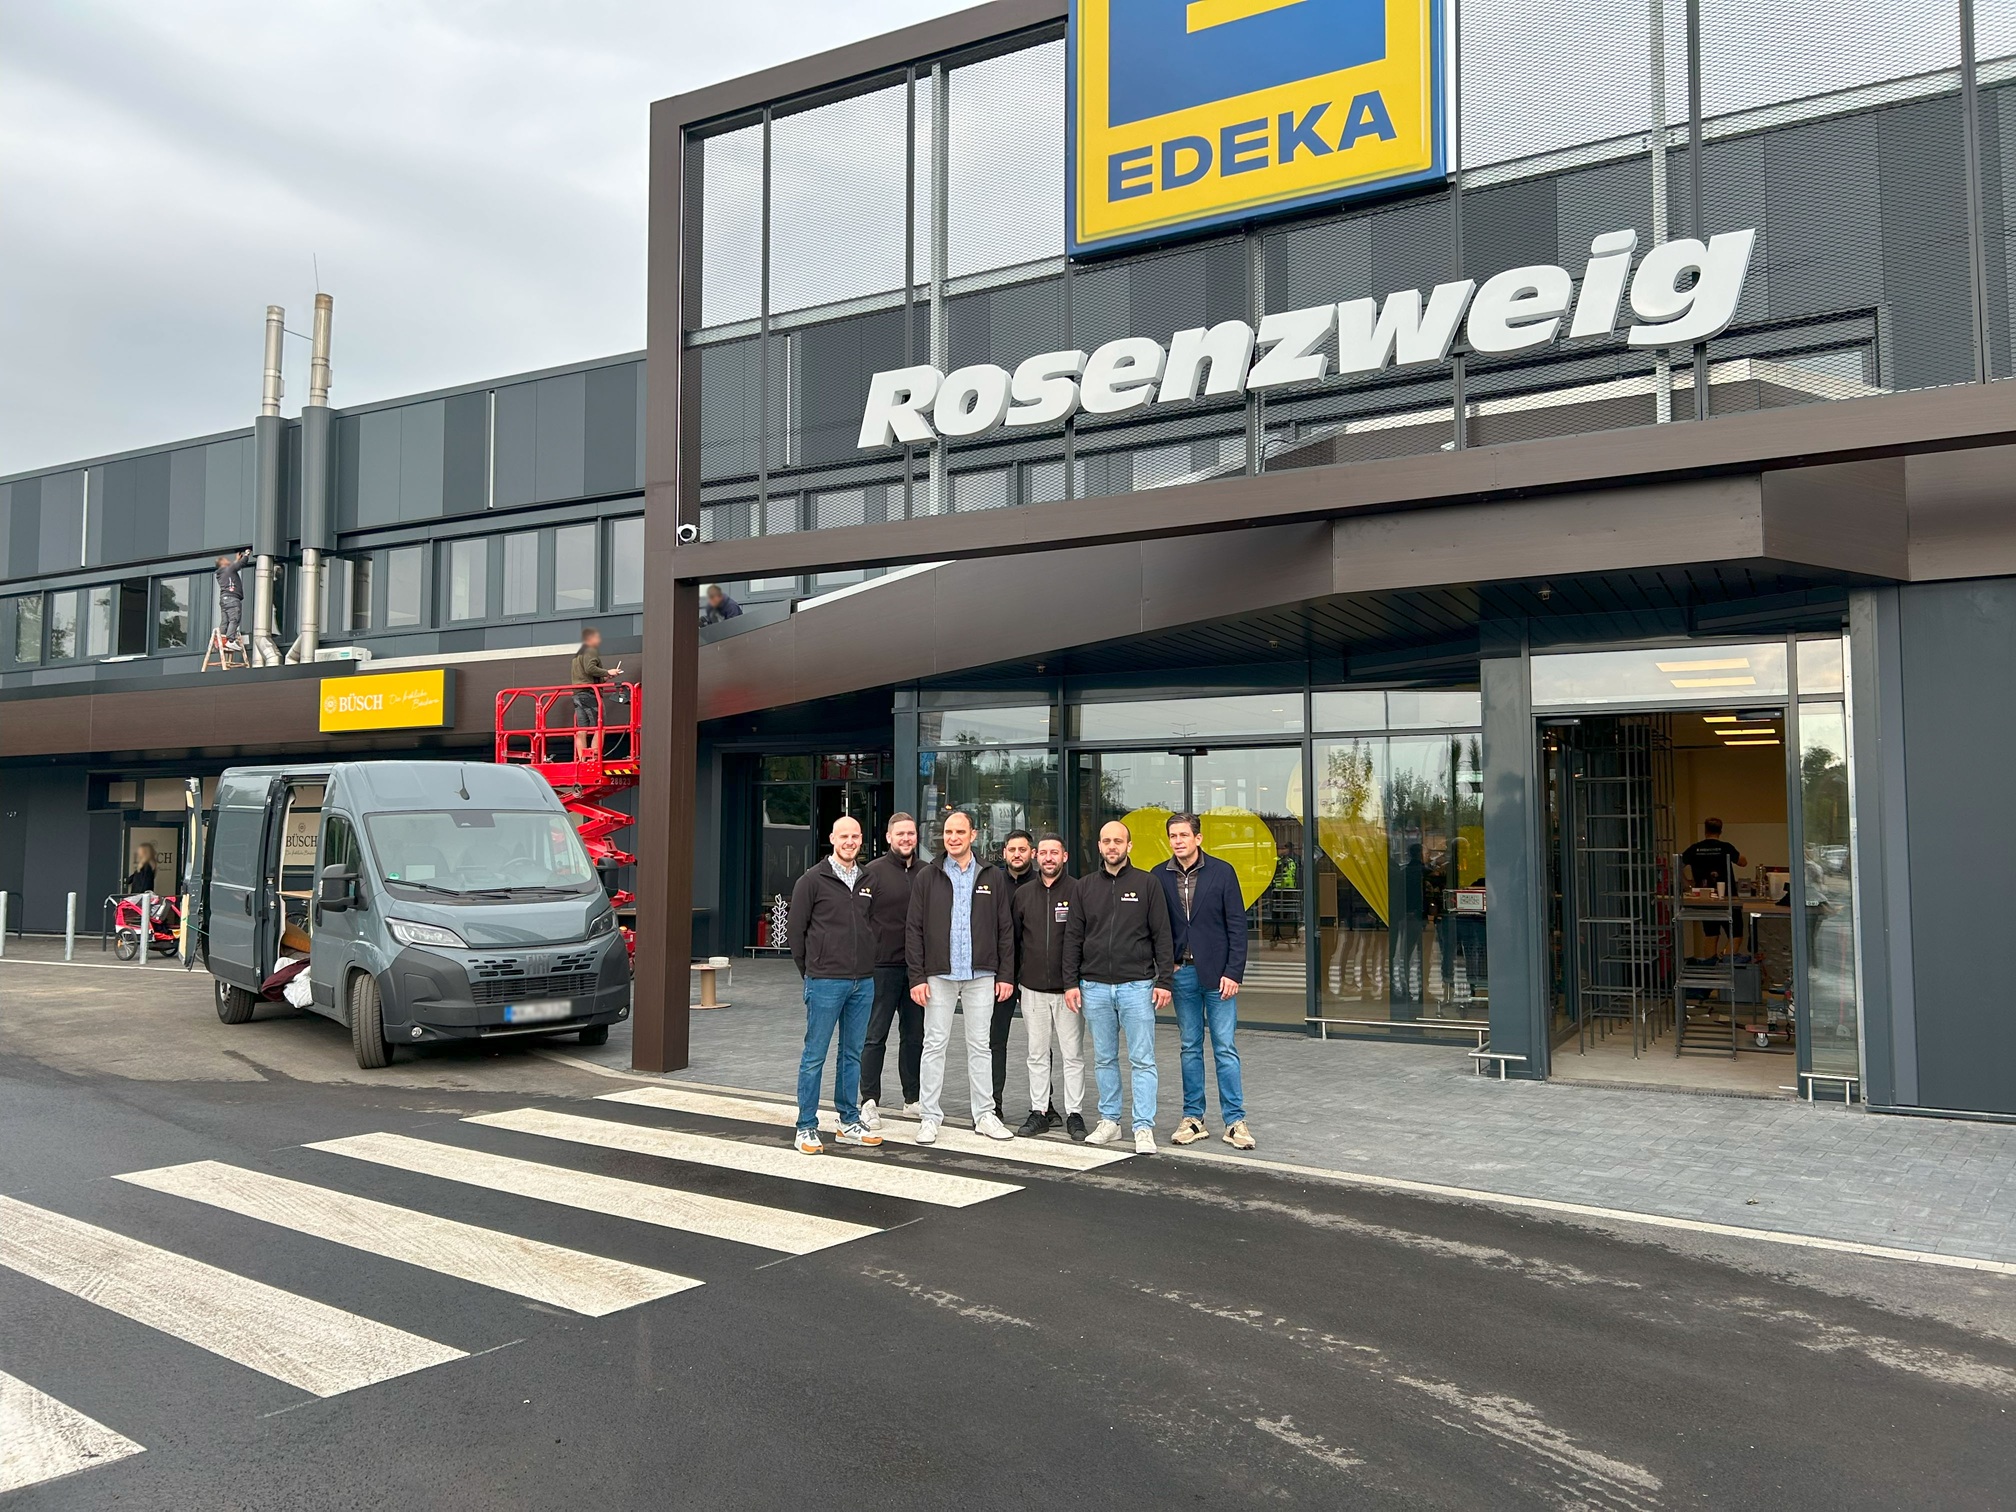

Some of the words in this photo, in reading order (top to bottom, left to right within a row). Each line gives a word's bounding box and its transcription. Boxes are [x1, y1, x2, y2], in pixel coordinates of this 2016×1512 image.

[1108, 90, 1397, 203] EDEKA
[856, 228, 1756, 449] Rosenzweig
[339, 693, 383, 712] BÜSCH
[285, 833, 318, 848] BÜSCH
[526, 953, 551, 975] FIAT
